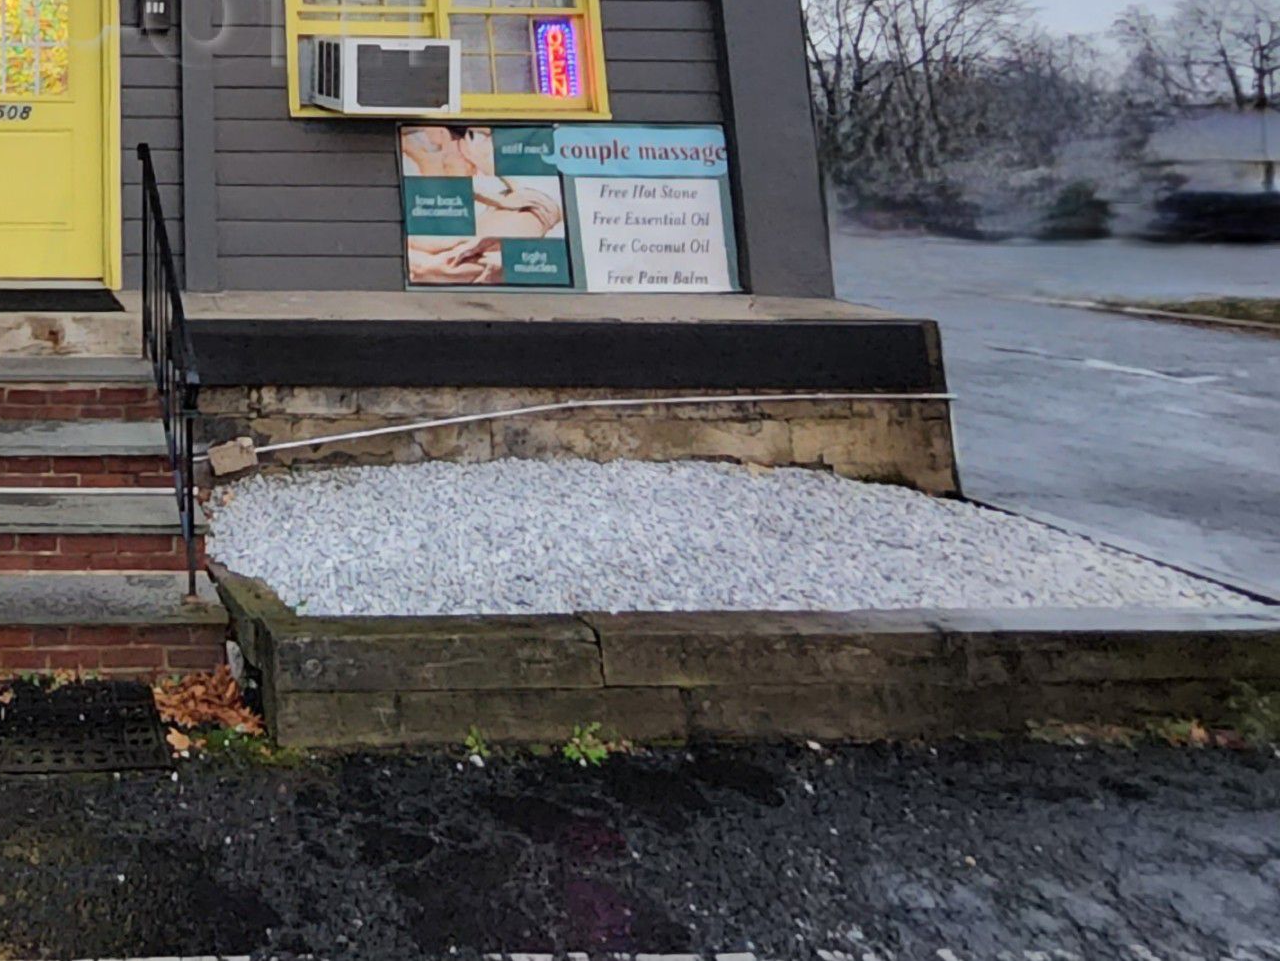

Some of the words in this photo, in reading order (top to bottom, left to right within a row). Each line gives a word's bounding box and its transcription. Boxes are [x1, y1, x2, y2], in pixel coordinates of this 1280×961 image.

[559, 139, 631, 165] couple
[638, 144, 728, 167] massage
[599, 185, 627, 199] Free
[632, 185, 657, 199] Hot
[660, 185, 698, 199] Stone
[592, 211, 621, 225] Free
[624, 212, 686, 226] Essential
[691, 212, 710, 226] Oil
[598, 238, 626, 253] Free
[631, 239, 686, 253] Coconut
[690, 239, 710, 254] Oil
[607, 270, 634, 284] Free
[638, 270, 668, 284] Pain
[673, 270, 709, 285] Balm
